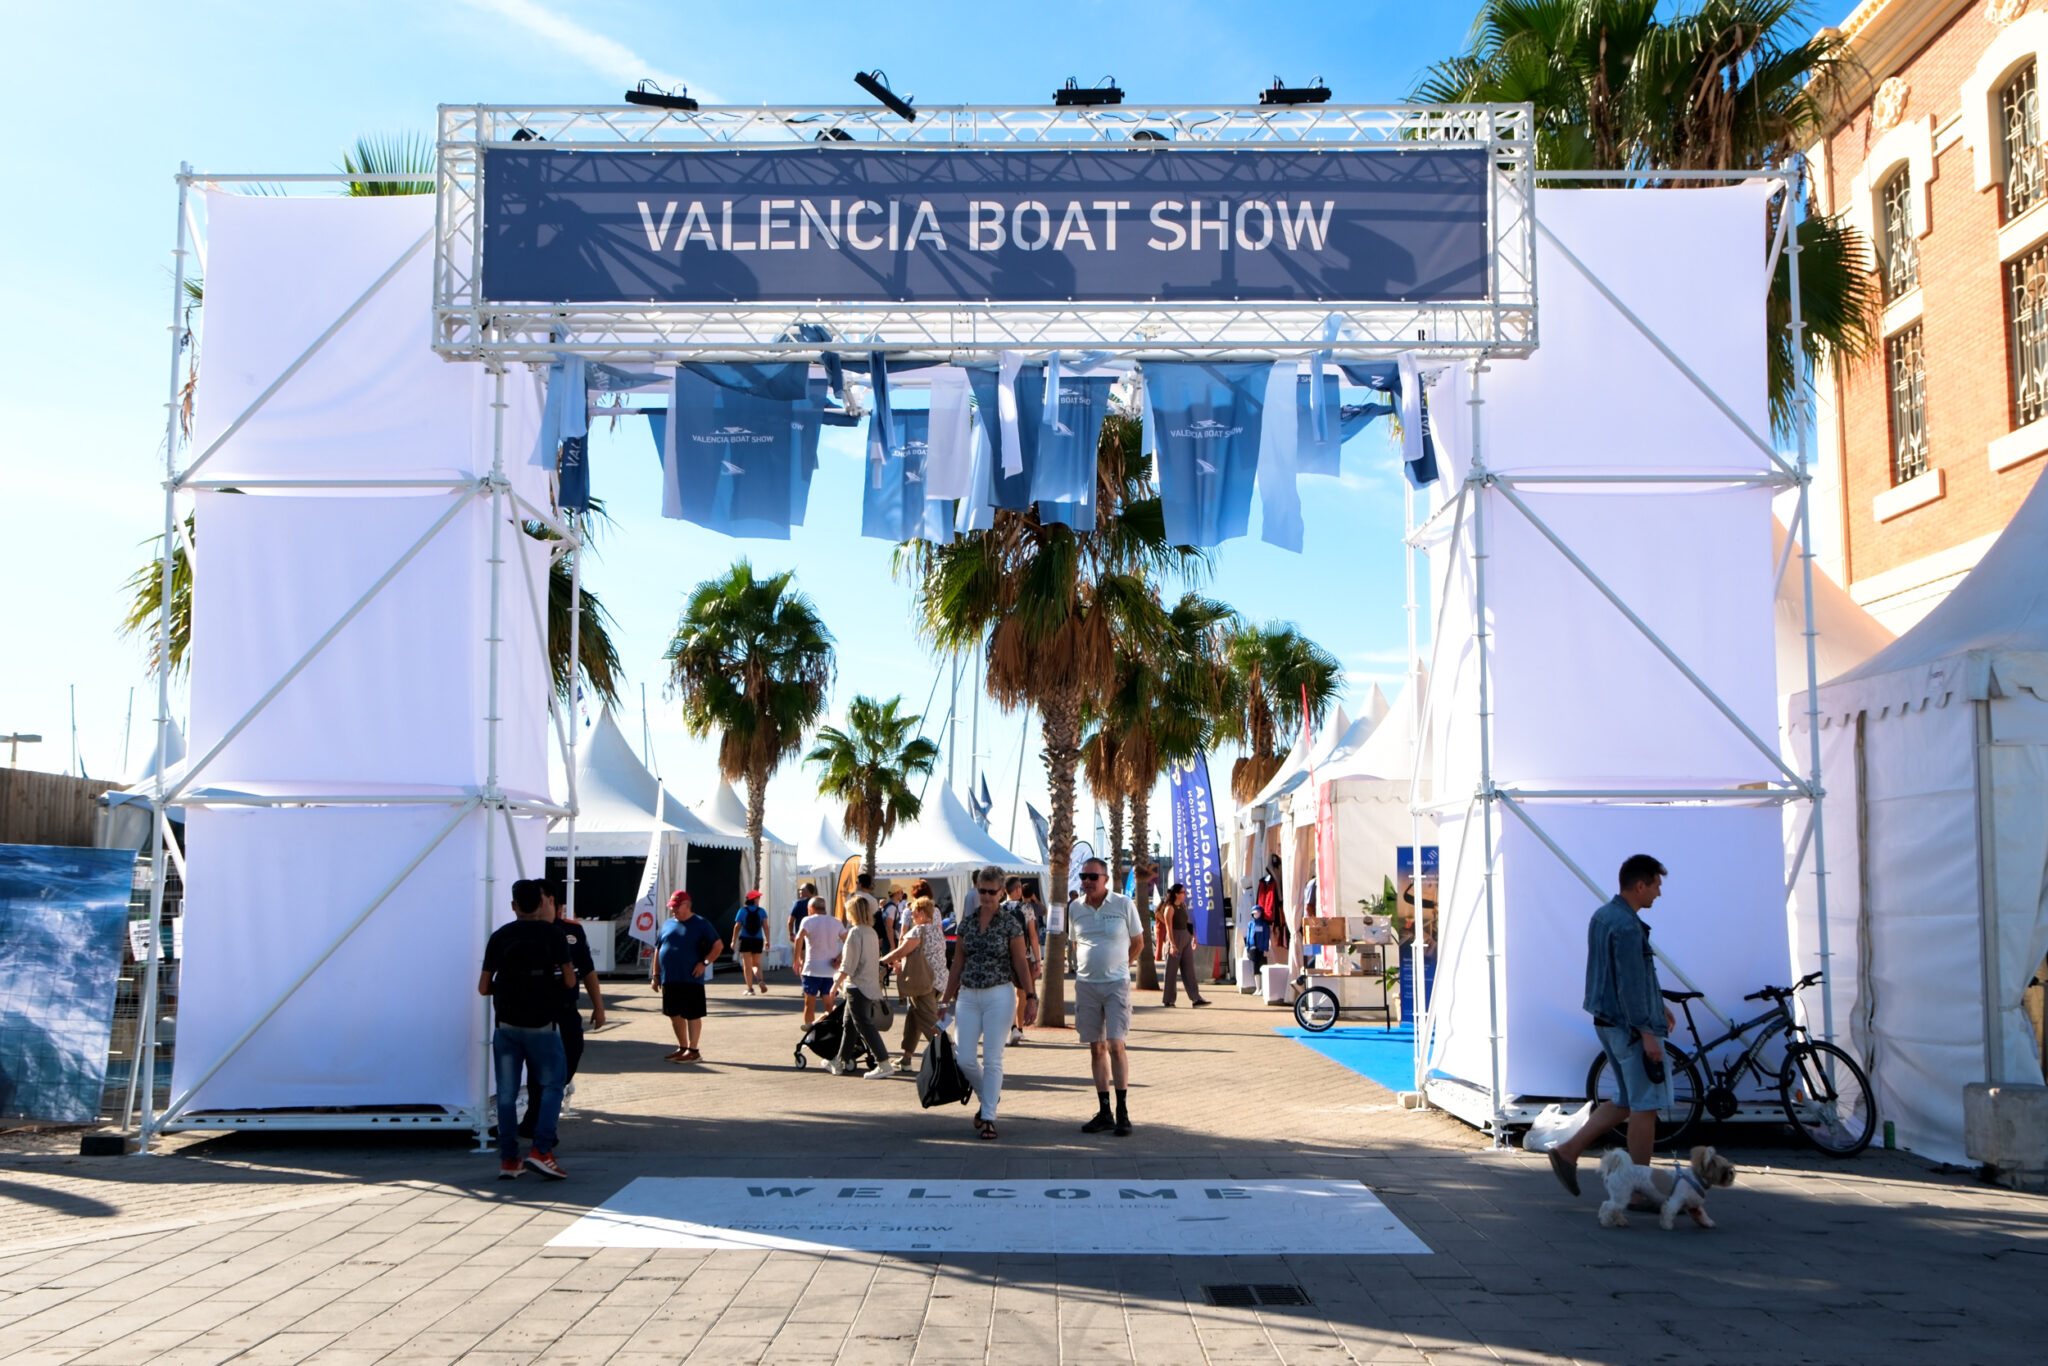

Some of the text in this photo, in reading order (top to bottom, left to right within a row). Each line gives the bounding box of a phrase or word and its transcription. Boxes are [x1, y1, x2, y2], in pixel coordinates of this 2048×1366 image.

[637, 200, 1335, 252] VALENCIA BOAT SHOW
[692, 434, 729, 443] VALENCIA
[1170, 427, 1243, 439] VALENCIA BOAT SHOW
[747, 1186, 1252, 1199] WELCOME
